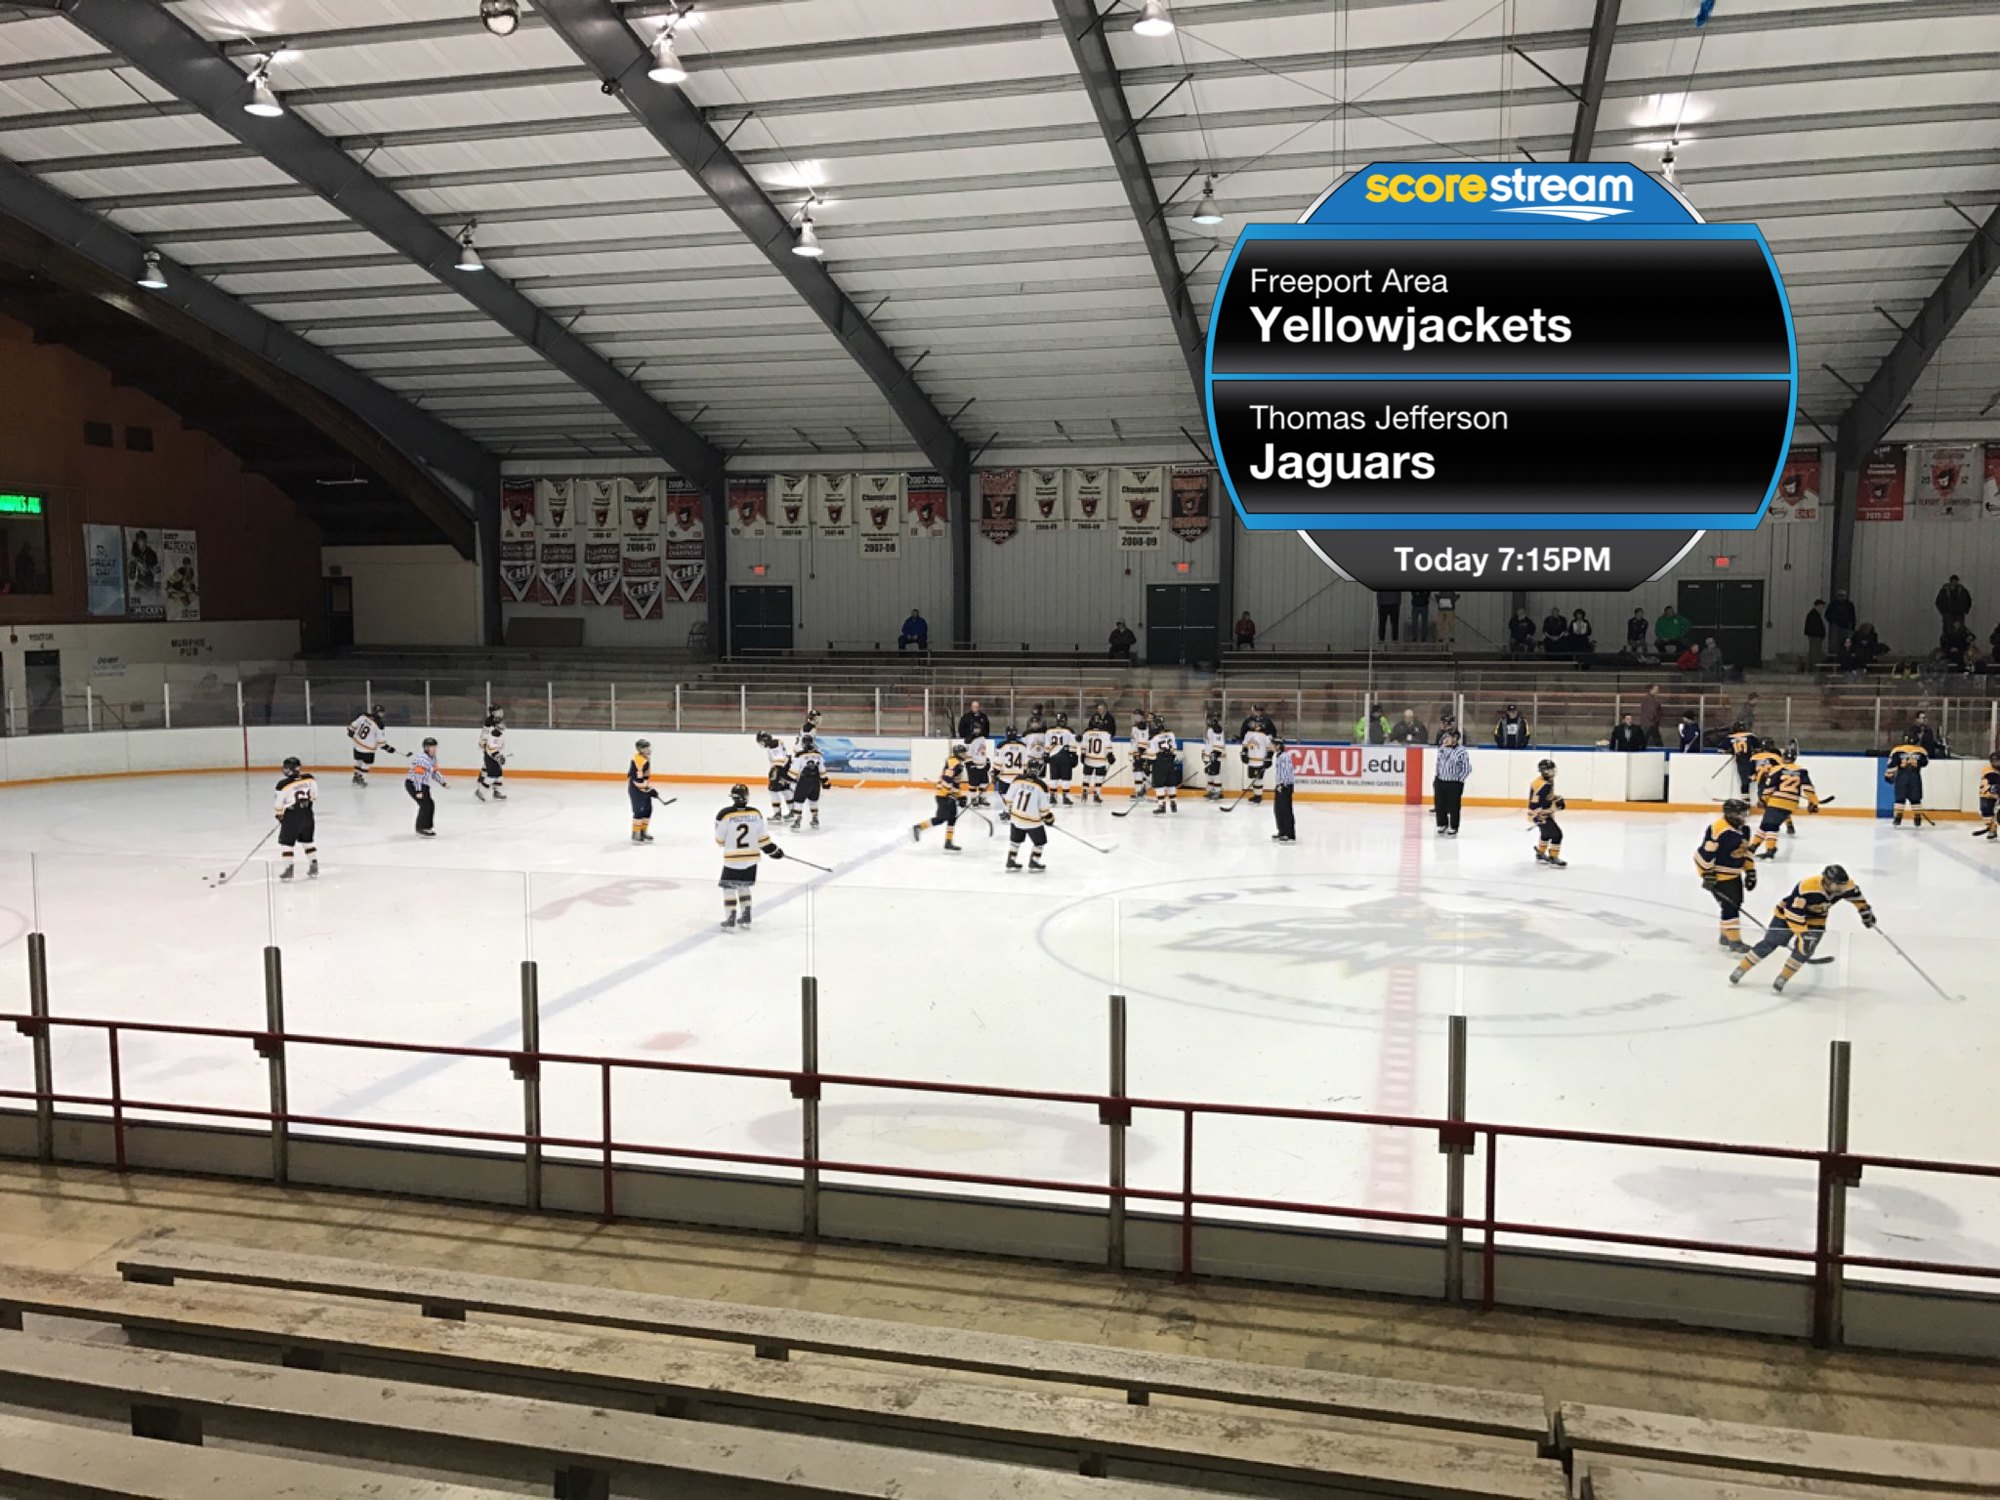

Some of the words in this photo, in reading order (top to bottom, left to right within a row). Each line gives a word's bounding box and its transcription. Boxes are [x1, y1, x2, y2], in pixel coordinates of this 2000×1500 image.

[1121, 537, 1158, 547] 2008-09
[1087, 737, 1102, 754] 10
[1004, 751, 1023, 769] 34
[1779, 774, 1801, 792] 22
[1018, 790, 1031, 813] 11
[736, 824, 749, 848] 2
